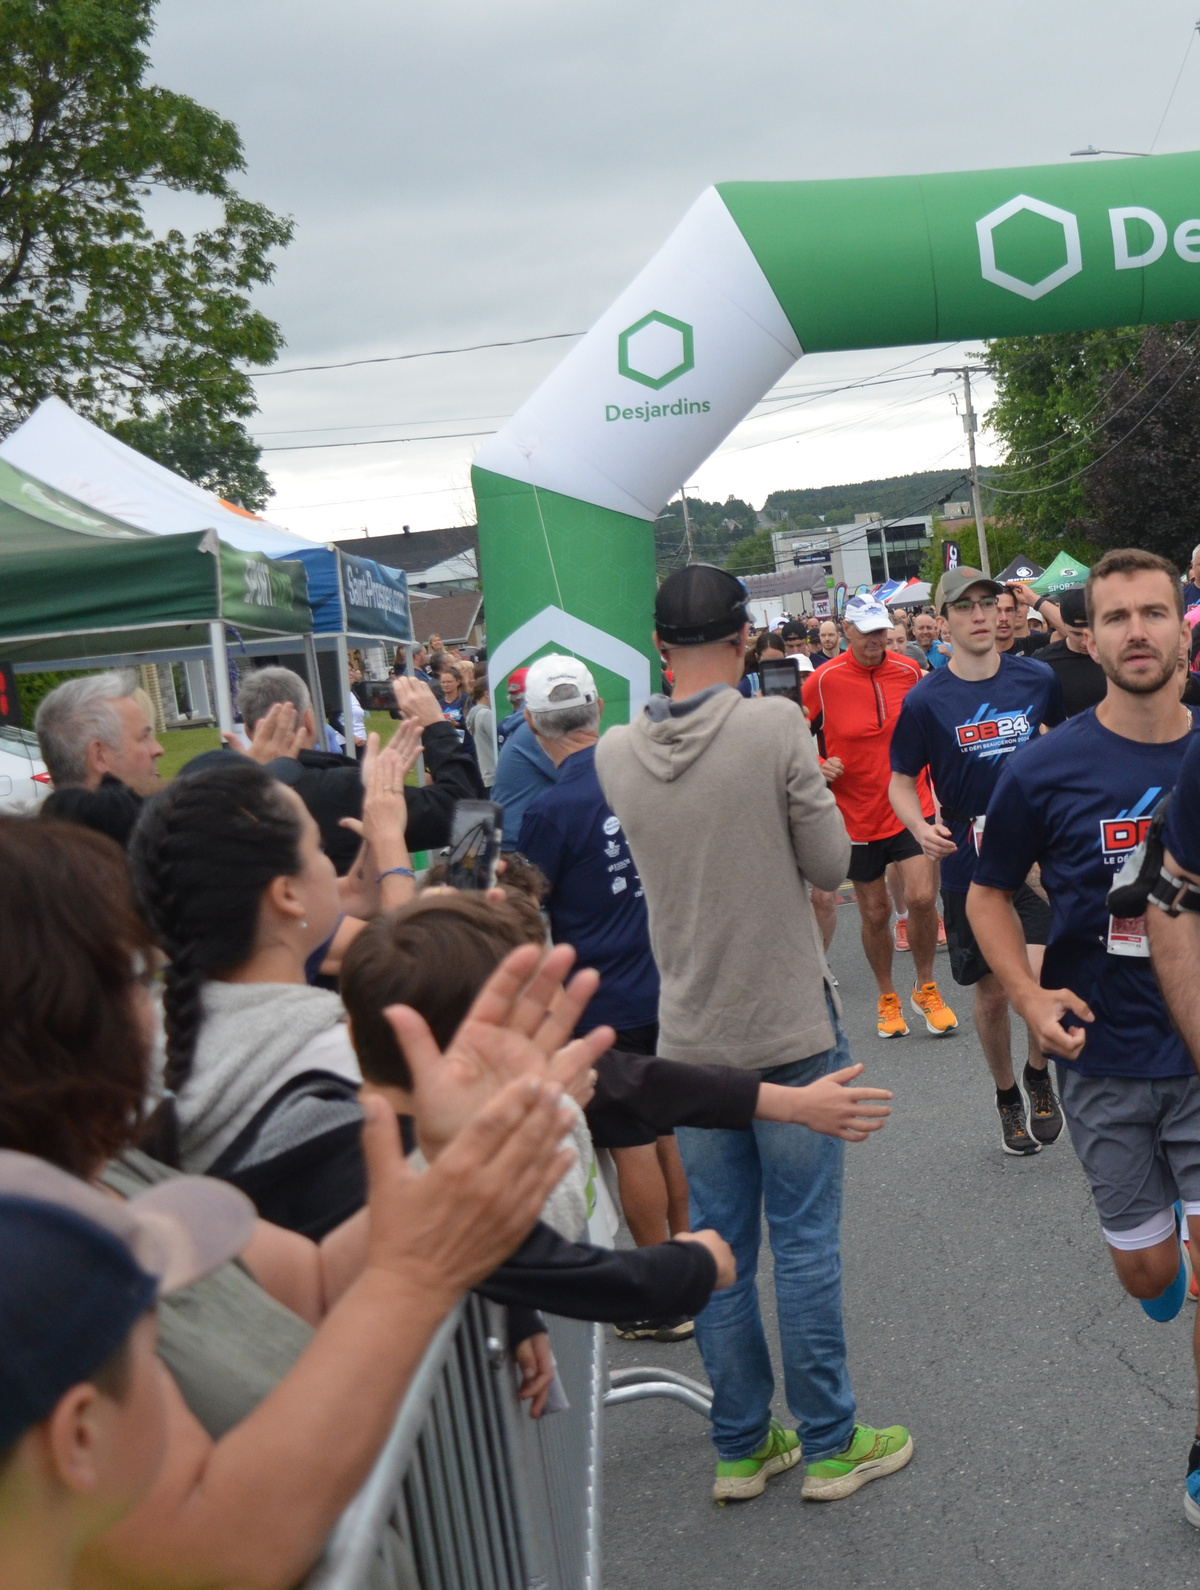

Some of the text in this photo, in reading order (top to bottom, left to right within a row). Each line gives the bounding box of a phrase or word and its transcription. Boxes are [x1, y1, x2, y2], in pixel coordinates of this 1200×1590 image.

[605, 398, 711, 422] Desjardins
[955, 714, 1031, 747] DB24
[983, 737, 1017, 749] BEAUCERON
[1104, 857, 1116, 865] LE
